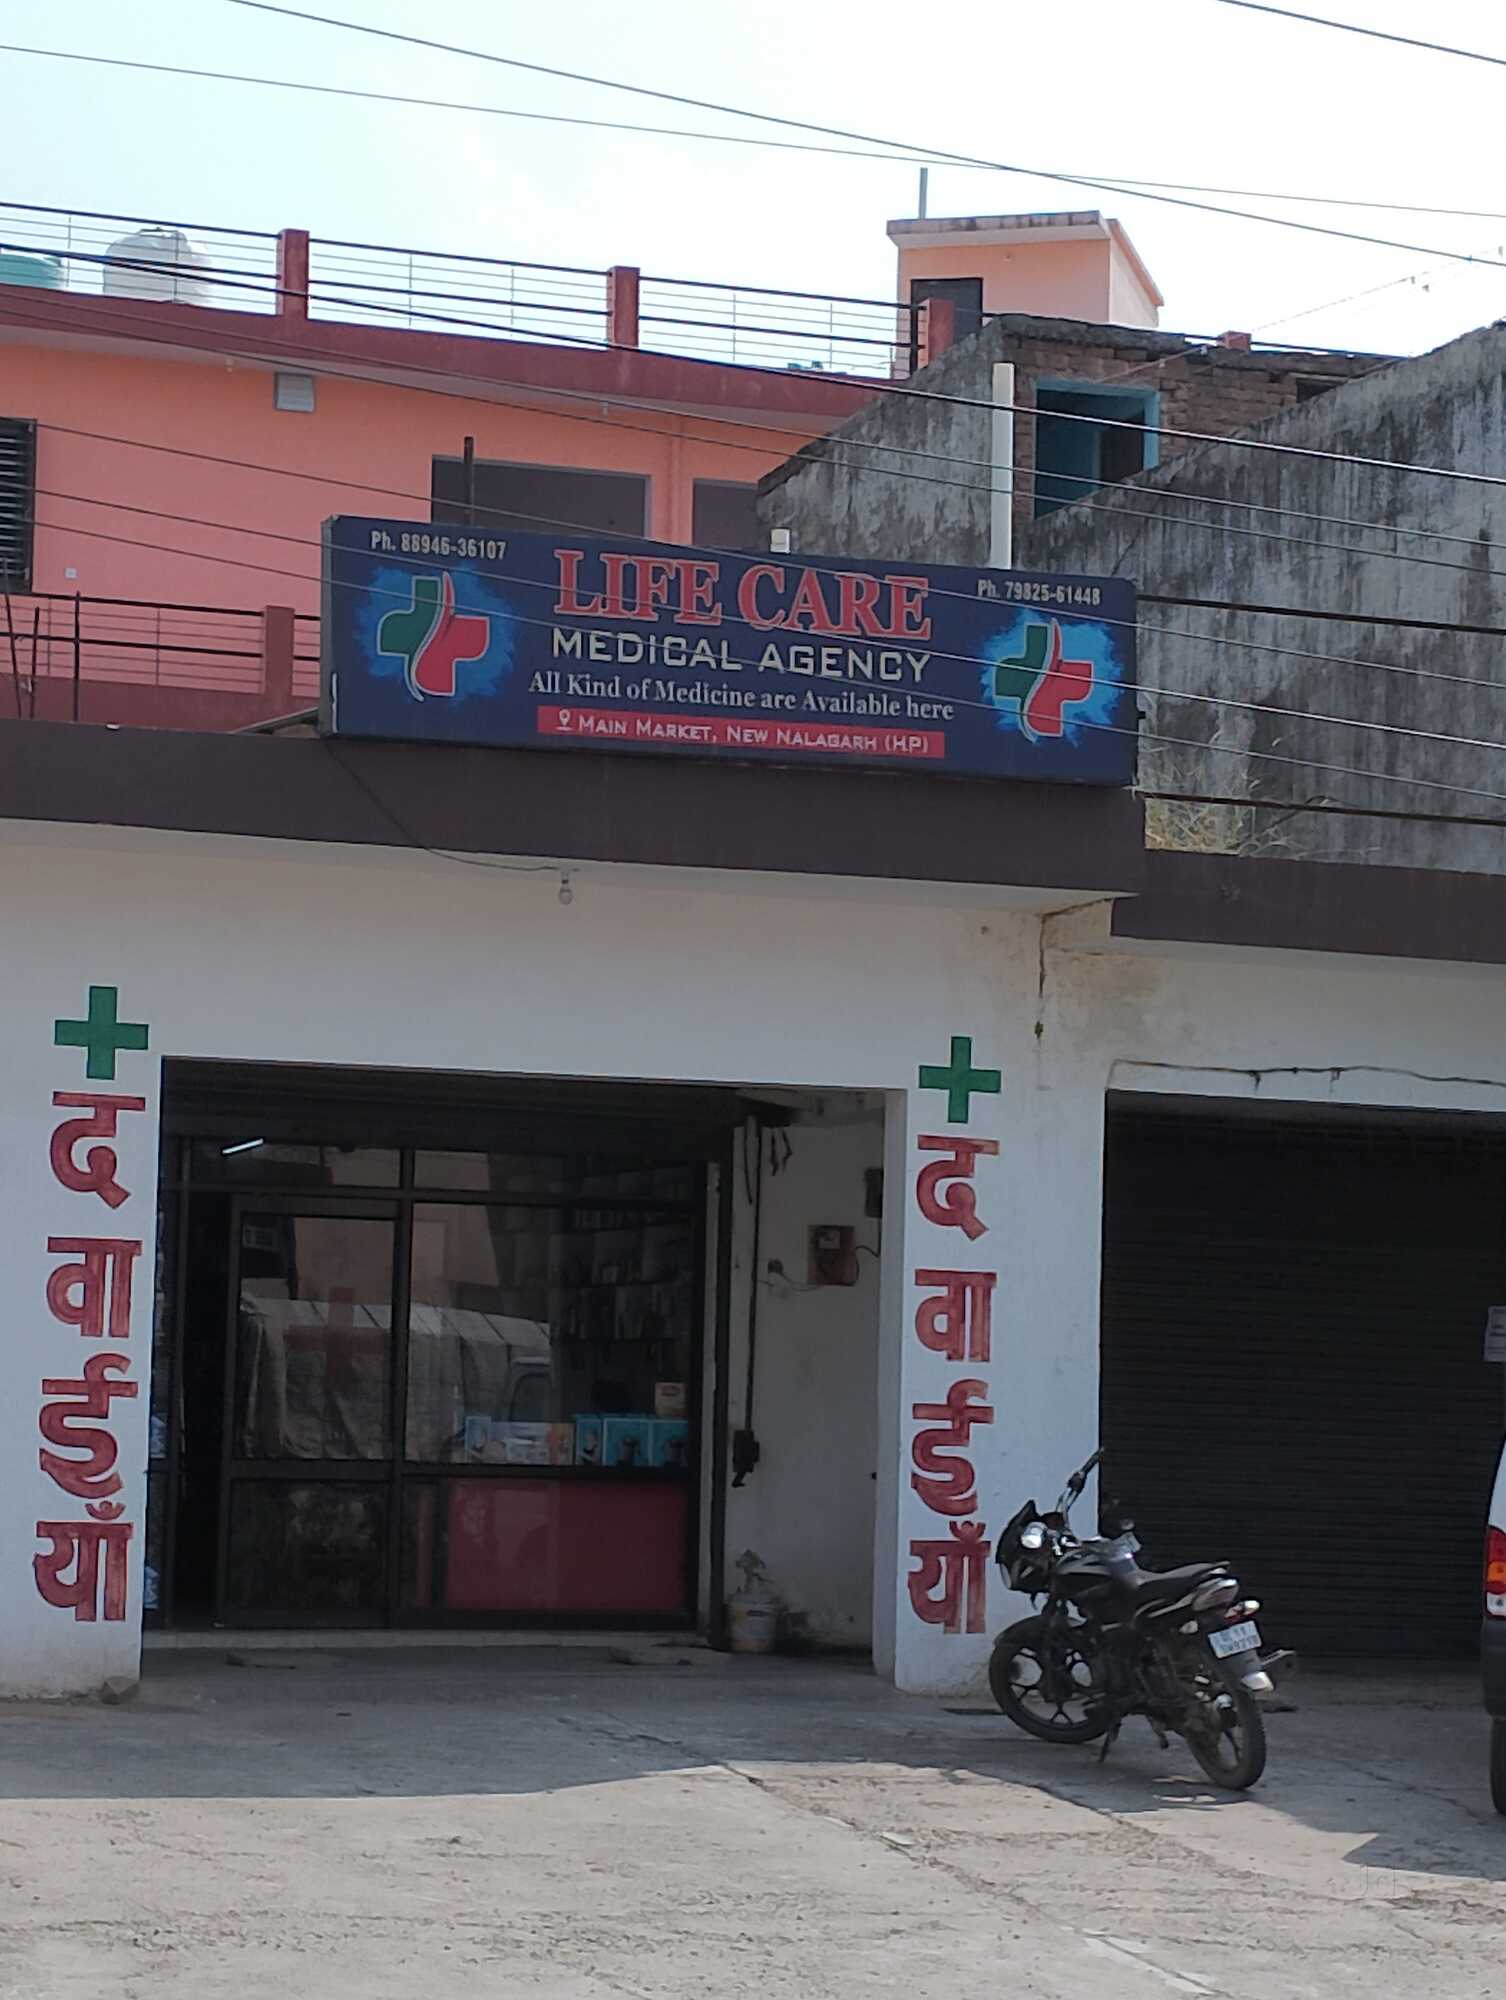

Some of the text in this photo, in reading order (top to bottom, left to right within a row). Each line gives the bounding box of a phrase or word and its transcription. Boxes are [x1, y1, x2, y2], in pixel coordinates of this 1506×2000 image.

[370, 530, 507, 560] Ph. 88946-36107
[553, 549, 932, 640] LIFE CARE
[977, 579, 1001, 598] Ph.
[552, 628, 931, 683] MEDICAL AGENCY
[528, 670, 954, 720] All Kind of Medicine are Available here
